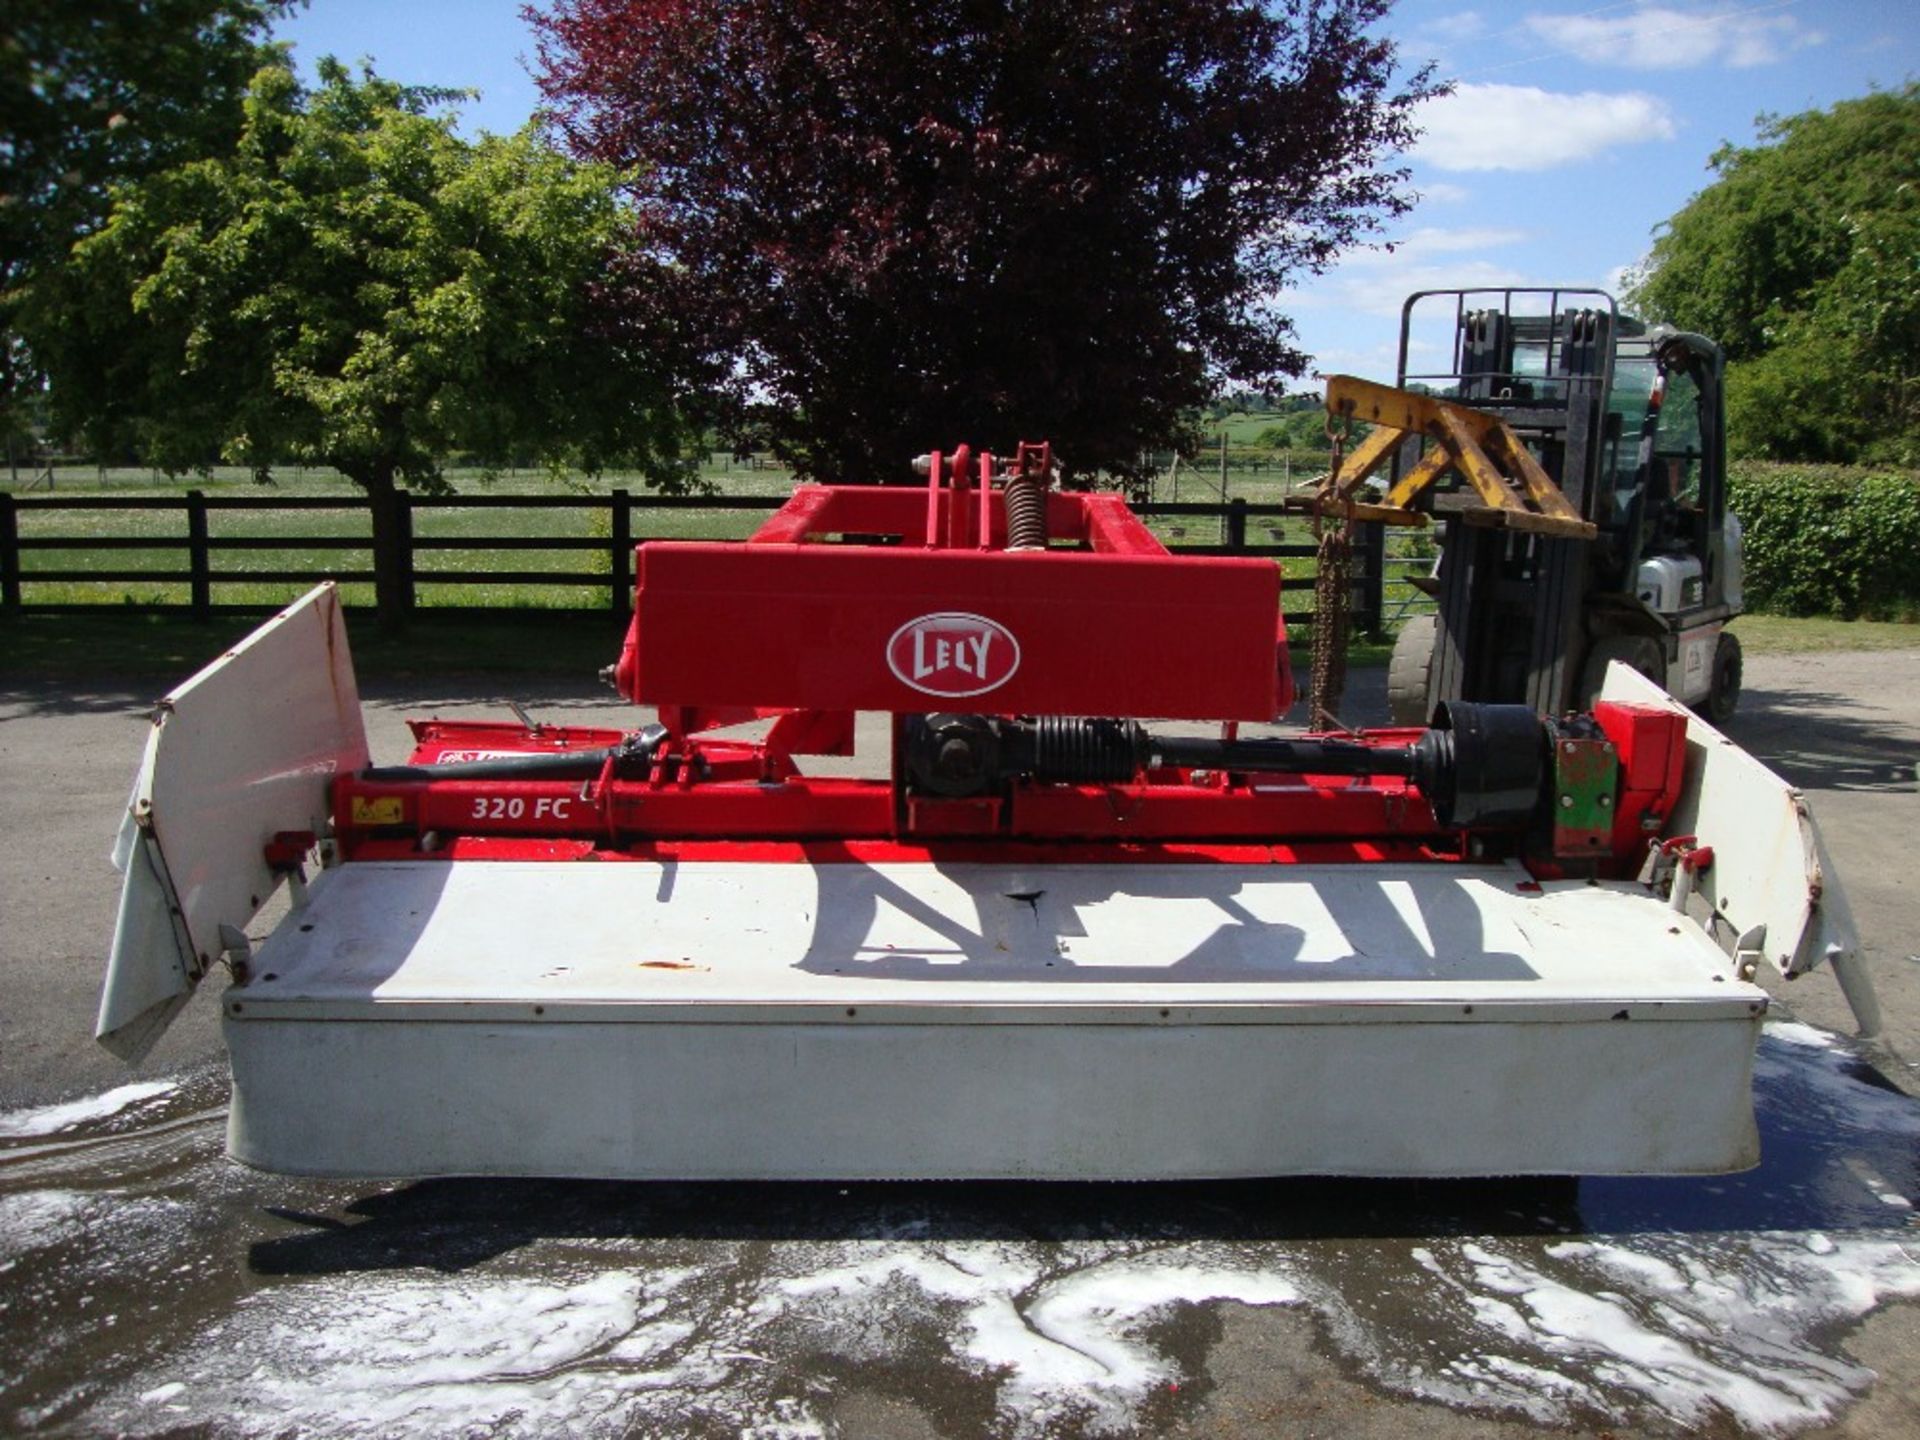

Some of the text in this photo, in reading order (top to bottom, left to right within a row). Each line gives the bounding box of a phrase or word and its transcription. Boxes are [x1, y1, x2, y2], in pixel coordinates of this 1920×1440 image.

[913, 629, 993, 680] LELY
[472, 798, 571, 819] 320 FC
